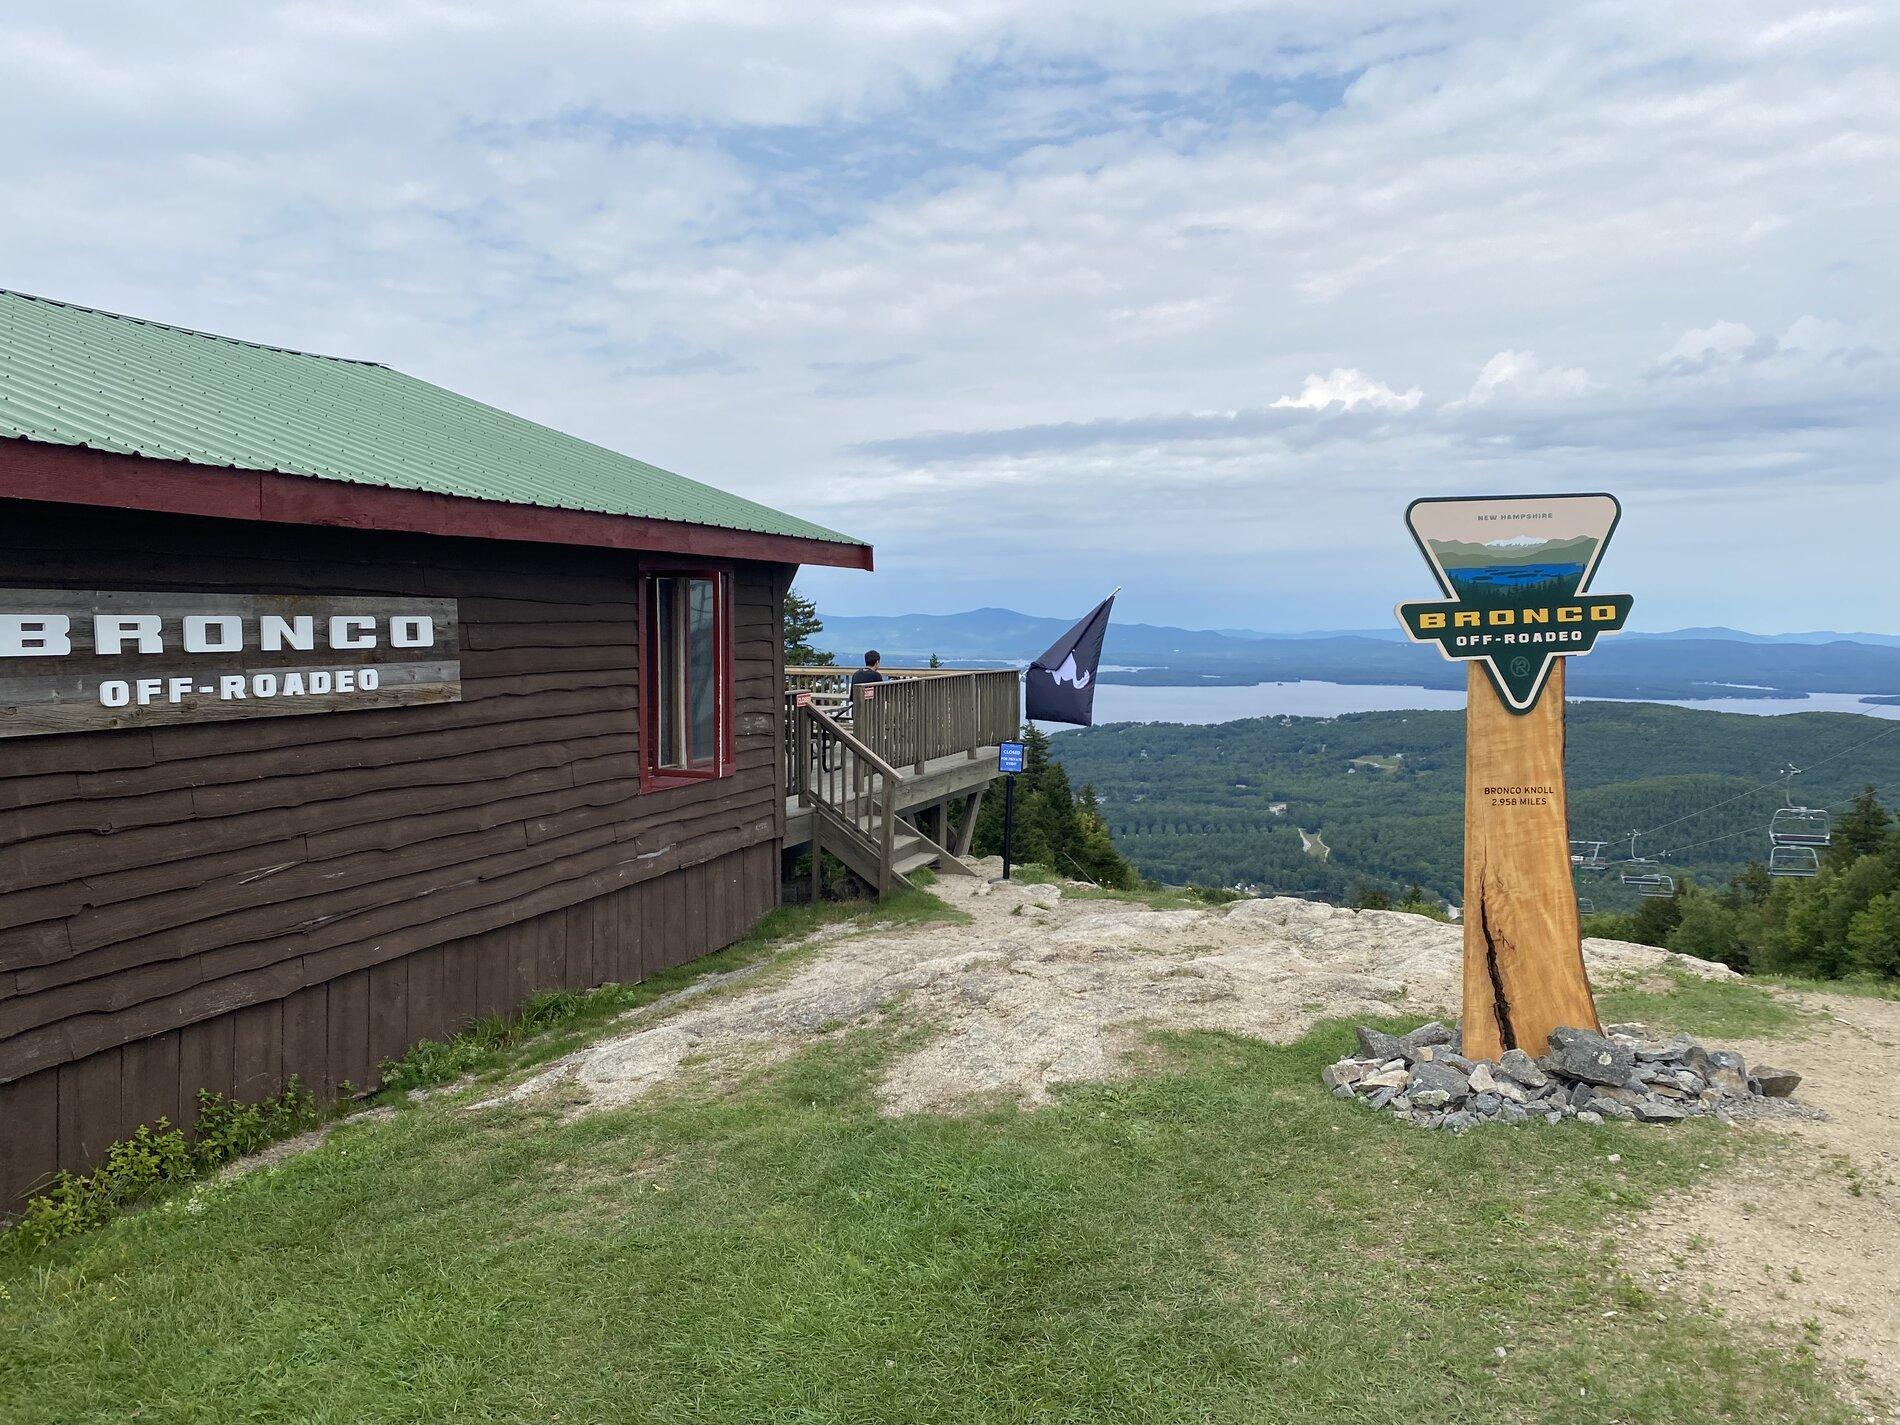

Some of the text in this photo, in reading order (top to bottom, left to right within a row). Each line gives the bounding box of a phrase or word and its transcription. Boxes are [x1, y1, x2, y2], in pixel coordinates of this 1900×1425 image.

[1419, 605, 1616, 629] BRONCO
[0, 614, 434, 657] BRONCO
[1456, 630, 1583, 647] OFF-ROADEO
[99, 668, 379, 707] OFF-ROADEO
[1524, 786, 1554, 794] KNOLL
[1491, 797, 1547, 806] 2,958 MILES
